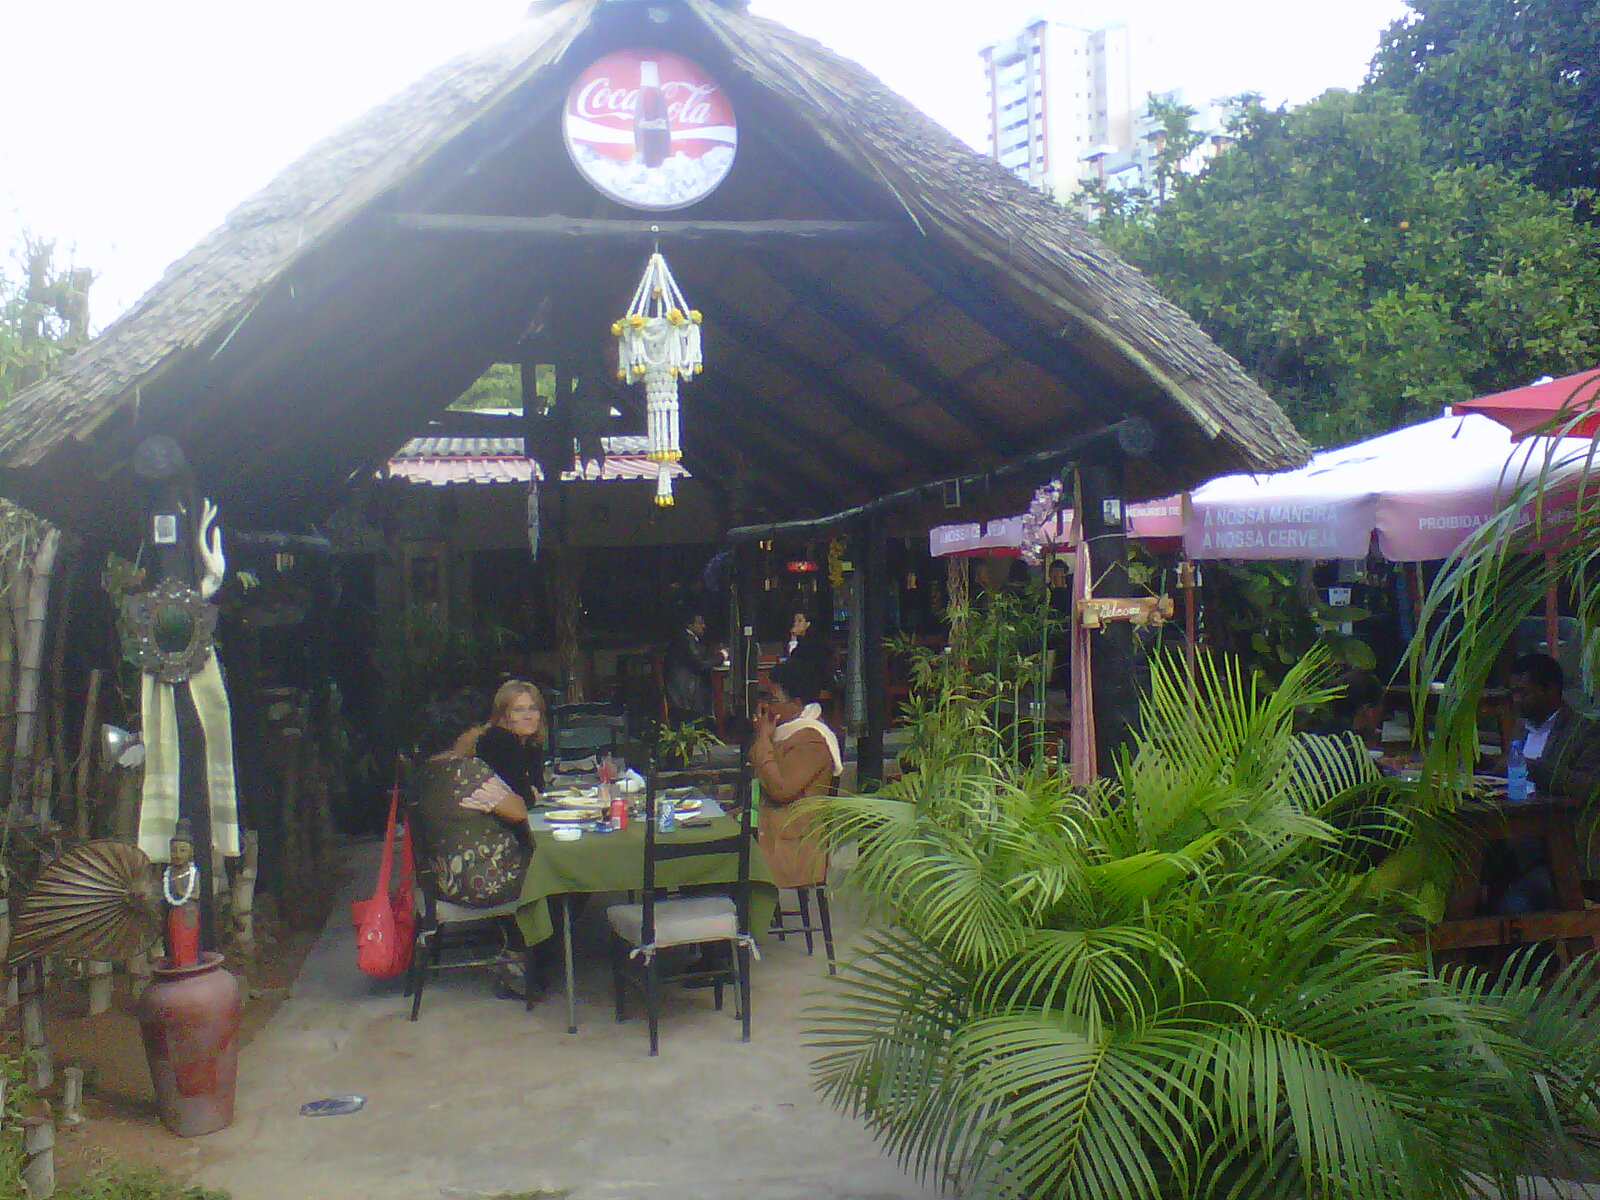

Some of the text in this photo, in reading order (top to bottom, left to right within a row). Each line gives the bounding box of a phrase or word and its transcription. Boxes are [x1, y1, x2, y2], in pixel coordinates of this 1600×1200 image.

[577, 77, 641, 120] Coca
[1204, 504, 1338, 526] A NOSSA MANEIRA
[1418, 515, 1481, 529] PROIBIDA
[1203, 528, 1338, 549] A NOSSA CERVEJA
